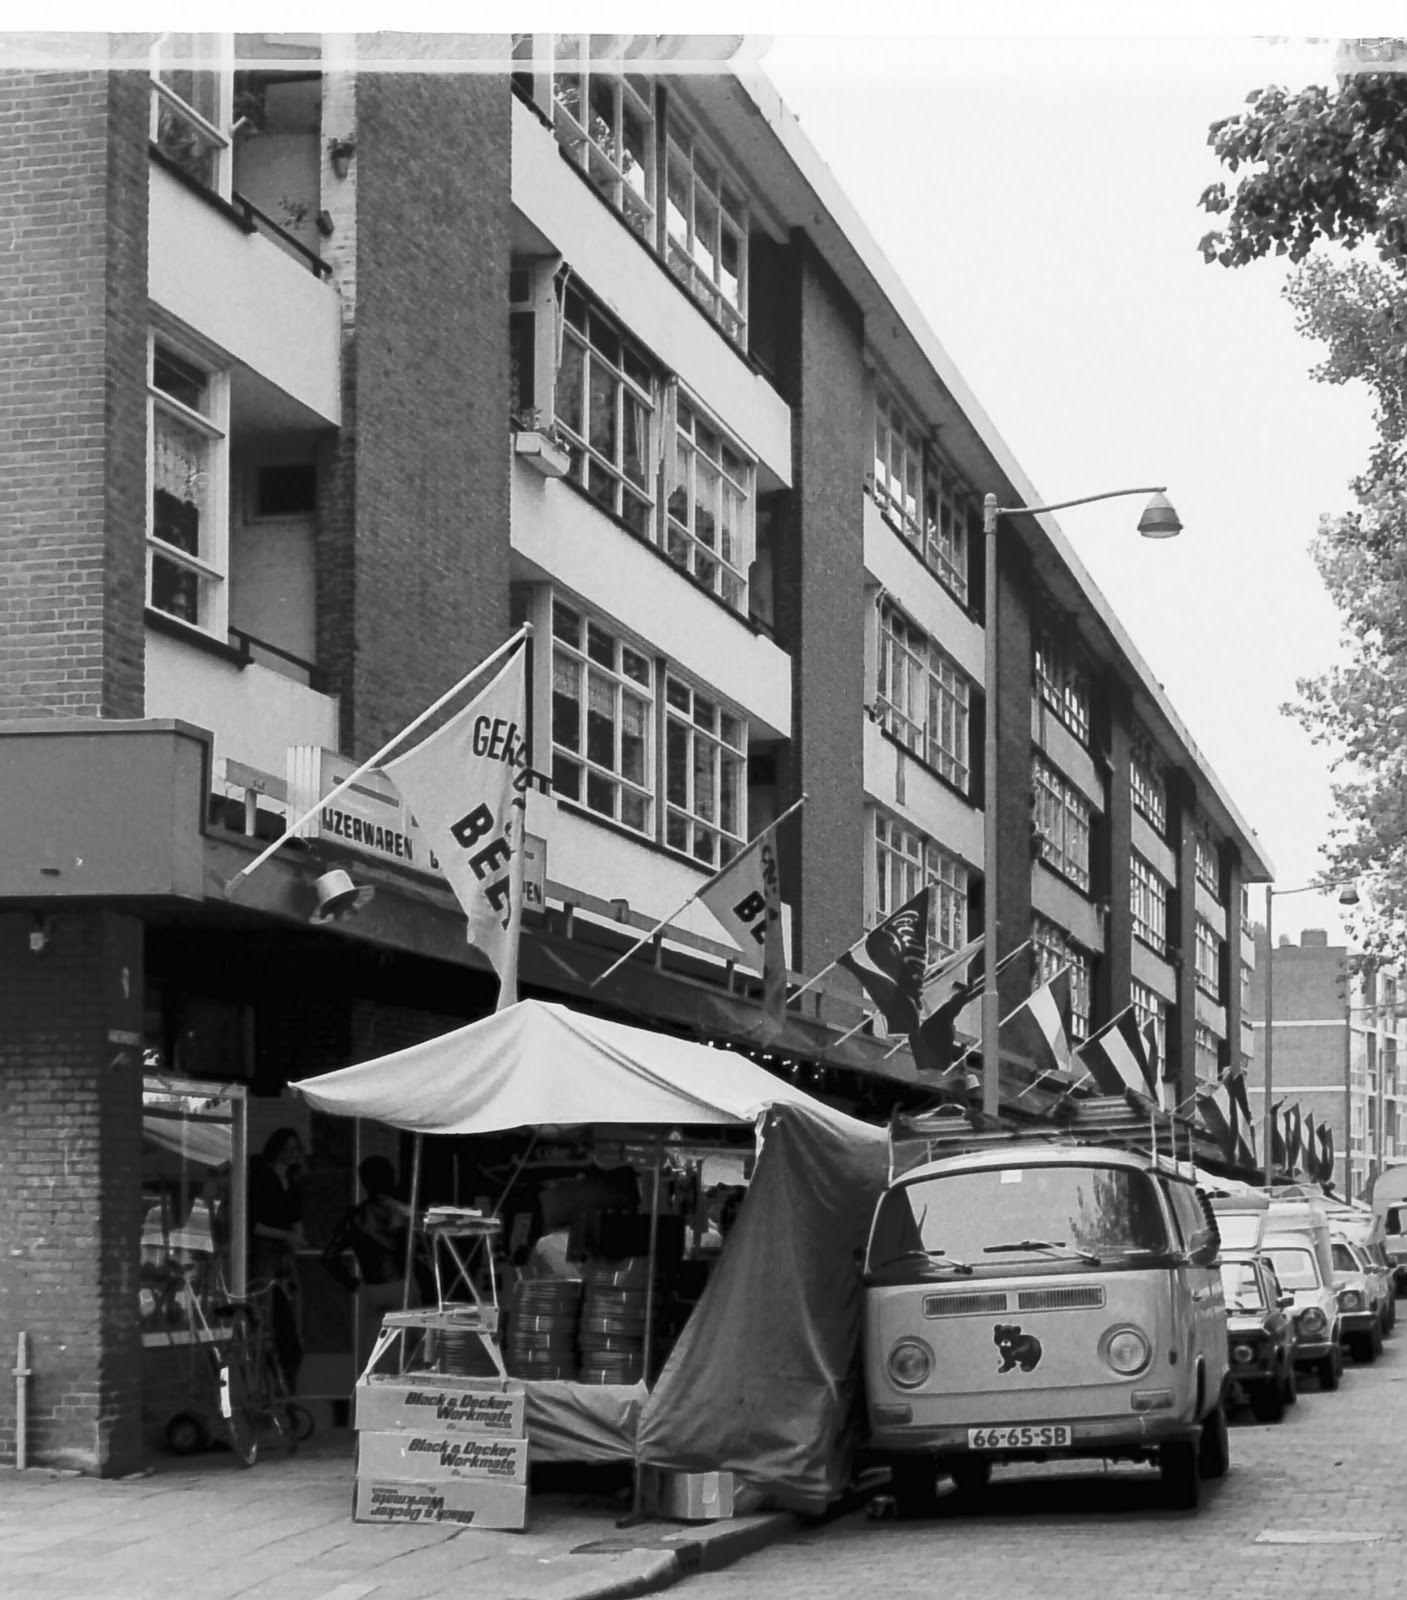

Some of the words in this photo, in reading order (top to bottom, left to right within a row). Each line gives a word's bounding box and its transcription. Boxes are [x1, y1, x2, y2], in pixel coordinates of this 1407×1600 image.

[404, 1391, 445, 1407] Black
[459, 1394, 513, 1410] Decker
[436, 1406, 513, 1424] Workmate
[973, 1427, 1067, 1448] 66-65-SB
[408, 1438, 450, 1453] Black
[463, 1441, 517, 1458] Decker
[440, 1453, 516, 1470] Workmate
[371, 1493, 445, 1510] Workmate
[370, 1506, 422, 1521] Decker
[435, 1509, 475, 1524] Black
